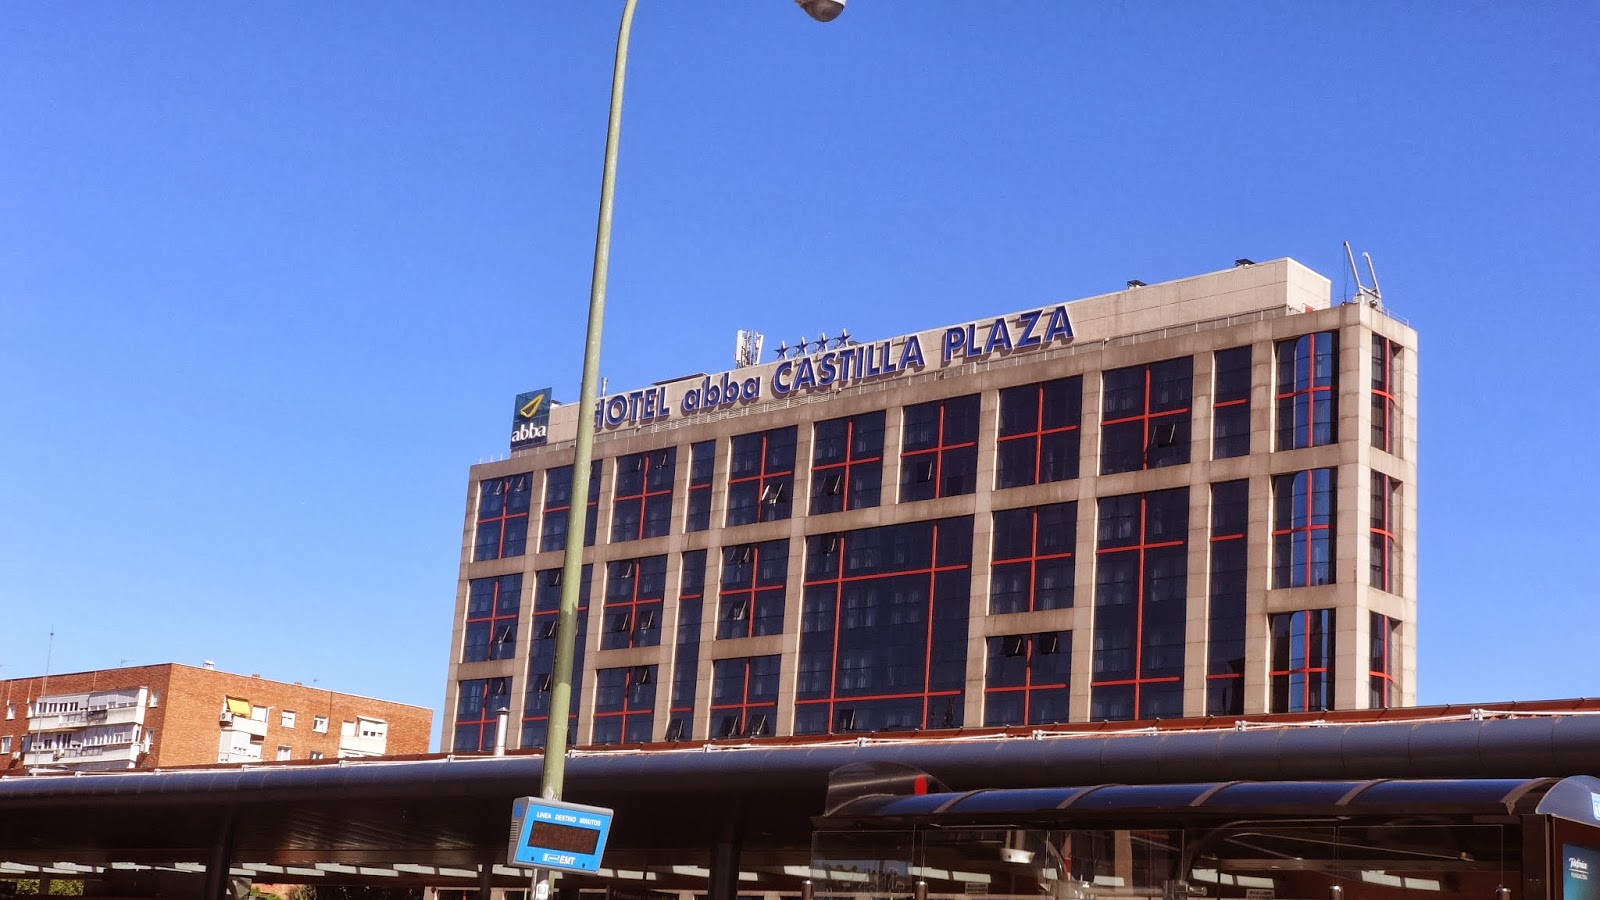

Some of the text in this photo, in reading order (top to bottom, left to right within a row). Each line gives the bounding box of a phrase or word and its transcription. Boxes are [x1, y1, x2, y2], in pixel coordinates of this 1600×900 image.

[682, 373, 762, 412] abba
[773, 335, 926, 396] CASTILLA
[943, 305, 1075, 361] PLAZA
[511, 422, 547, 443] abba
[559, 855, 576, 865] EMT
